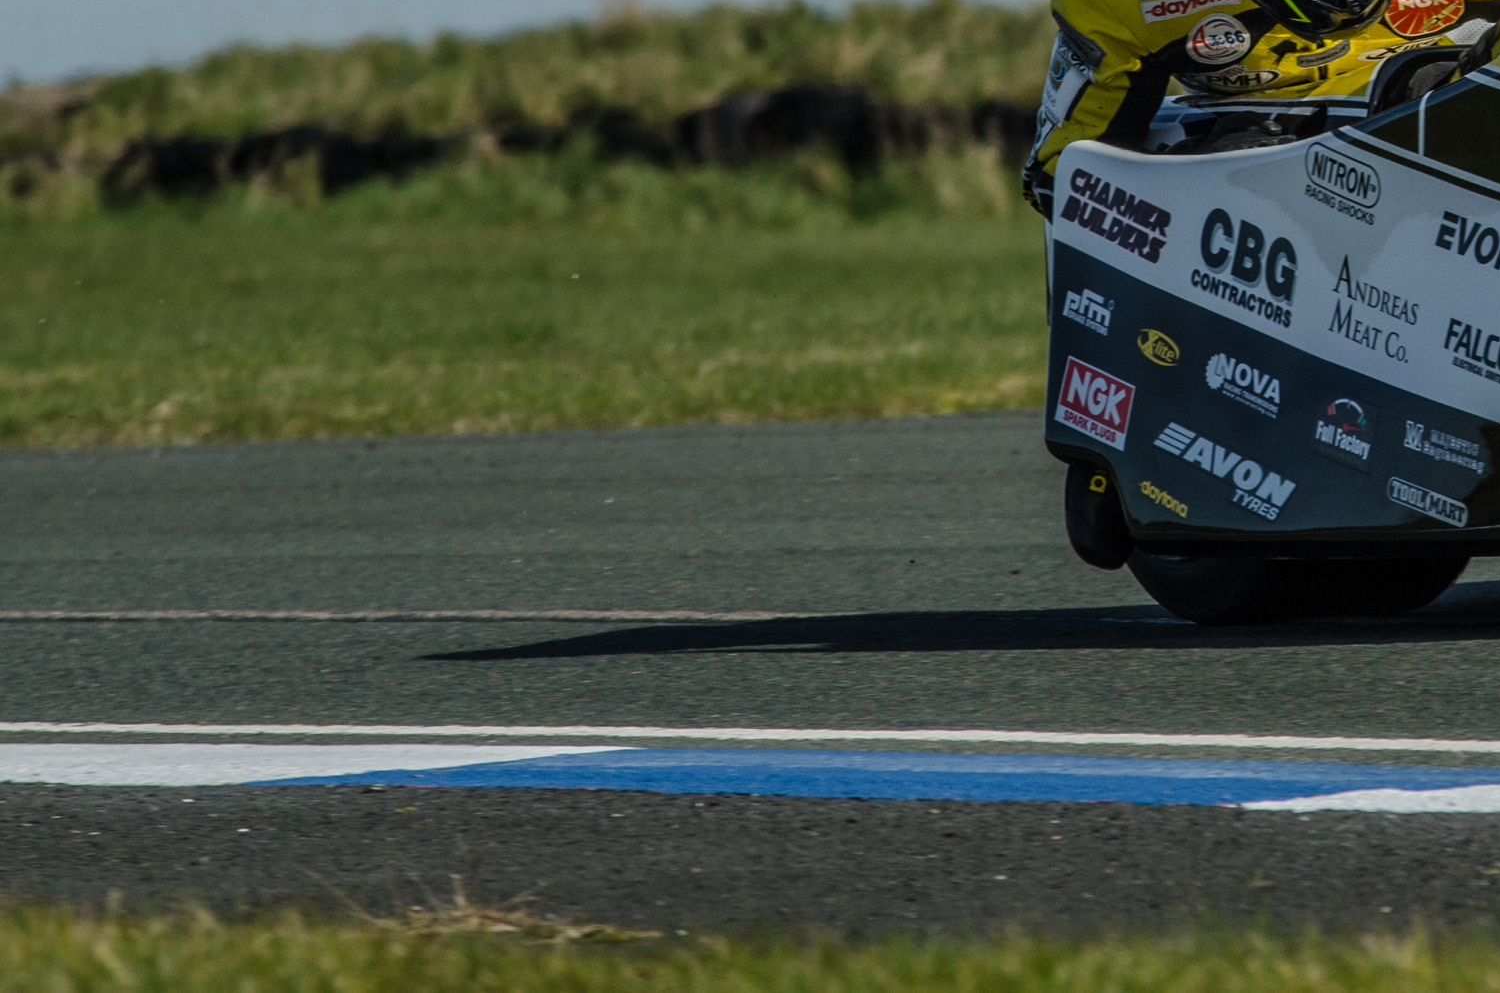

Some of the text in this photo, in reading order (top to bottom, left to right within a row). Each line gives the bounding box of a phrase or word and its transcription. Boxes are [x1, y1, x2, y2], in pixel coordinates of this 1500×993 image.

[1311, 151, 1371, 200] NITRON
[1070, 168, 1172, 238] CHARMER
[1304, 184, 1375, 226] RACING SHOCKS
[1060, 194, 1168, 264] BUILDERS
[1201, 208, 1298, 306] CBG
[1191, 269, 1293, 328] CONTRACTORS
[1141, 330, 1176, 362] X-lite
[1066, 366, 1126, 426] NGK
[1214, 353, 1281, 404] NOVA
[1063, 409, 1117, 443] SPARK PLUGS
[1315, 420, 1371, 460] Full Factory
[1182, 437, 1297, 507] AVON
[1139, 480, 1189, 518] daytona
[1232, 489, 1280, 521] TYRES
